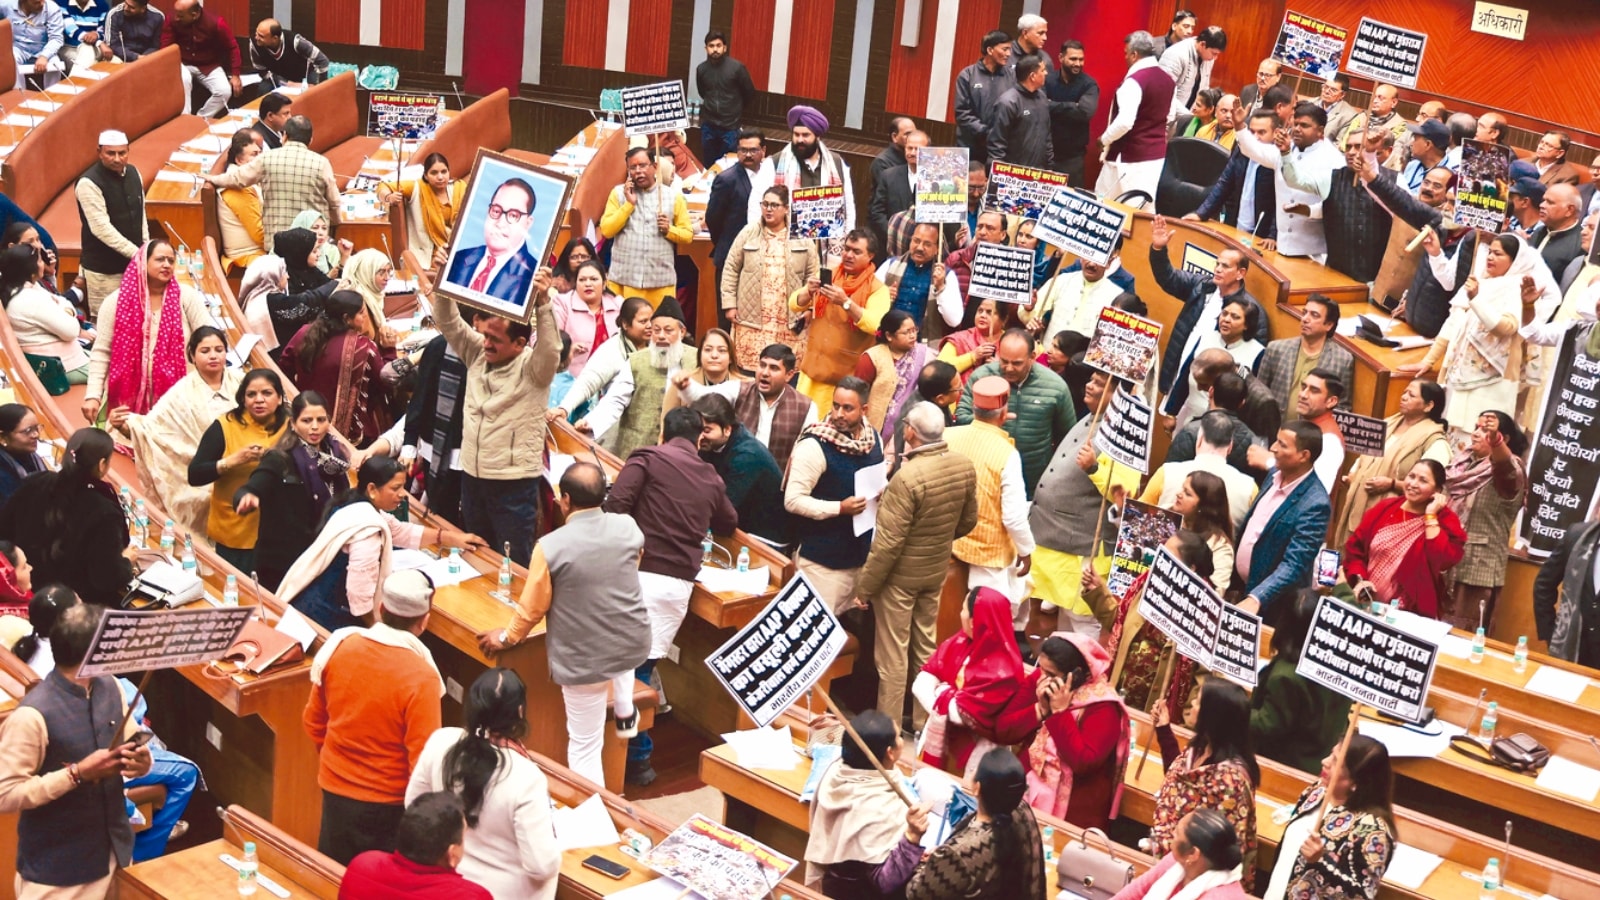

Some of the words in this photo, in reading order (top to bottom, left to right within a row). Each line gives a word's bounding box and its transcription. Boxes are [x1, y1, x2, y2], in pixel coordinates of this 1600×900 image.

[1478, 9, 1523, 34] अधिकारी
[1371, 28, 1388, 40] AAP
[1570, 373, 1600, 391] वालों
[1573, 391, 1599, 410] हक
[1337, 414, 1355, 425] AAP
[1169, 567, 1189, 588] AAP
[216, 621, 241, 629] AAP
[760, 611, 782, 639] AAP
[1321, 603, 1344, 627] देखो
[1342, 616, 1372, 638] AAP
[1372, 630, 1389, 647] का
[1387, 636, 1430, 664] गुंडाराज
[129, 636, 163, 647] AAP
[730, 668, 754, 690] का
[750, 634, 791, 674] वसूली
[786, 598, 821, 639] कराना
[772, 682, 800, 710] भारतीय
[801, 660, 821, 683] जनता
[816, 642, 832, 660] पार्टी
[1316, 669, 1348, 689] भारतीय
[1351, 687, 1376, 701] जनता
[1379, 692, 1399, 709] पार्टी
